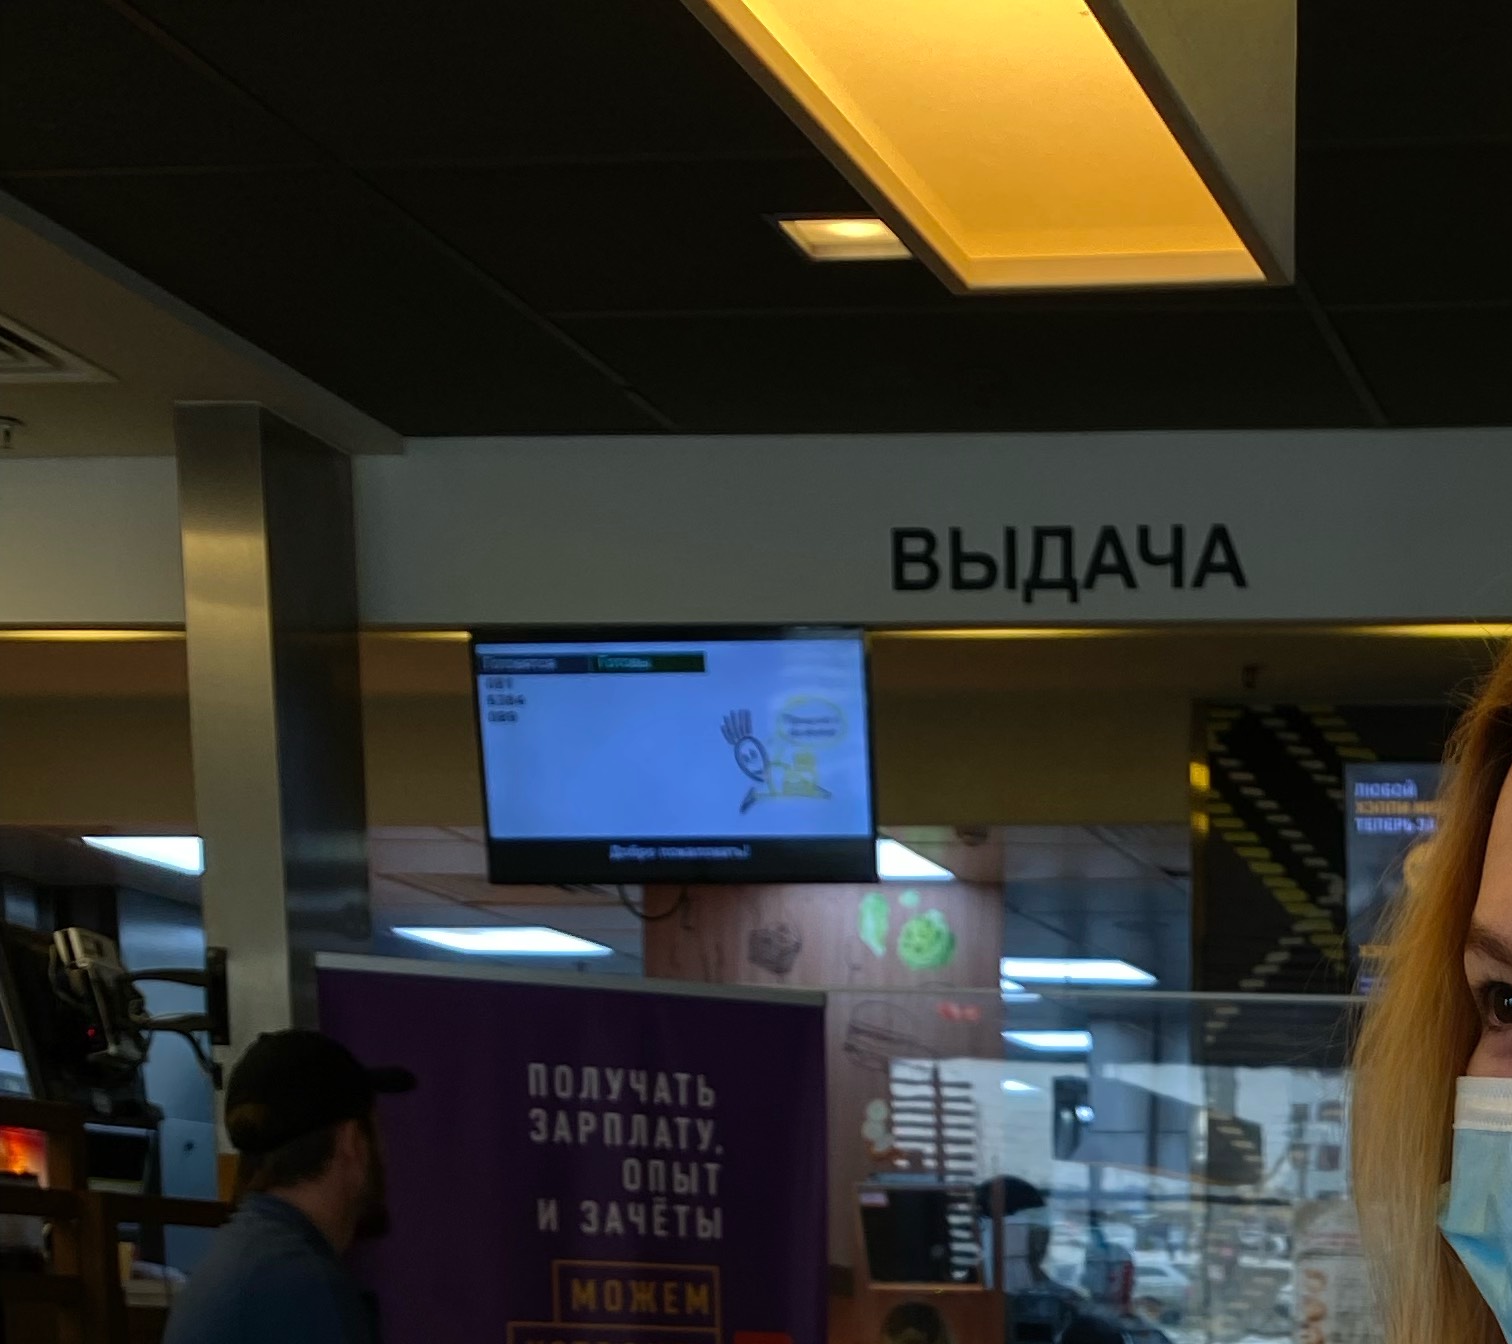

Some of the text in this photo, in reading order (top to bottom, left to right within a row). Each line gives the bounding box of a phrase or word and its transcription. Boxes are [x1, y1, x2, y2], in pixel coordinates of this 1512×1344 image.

[890, 523, 1248, 603] ВЫДАЧА
[527, 1062, 716, 1108] ПОЛУЧАТЬ
[622, 1158, 722, 1195] ОПЫТ
[537, 1198, 559, 1232] И
[571, 1278, 710, 1315] МОЖЕМ
